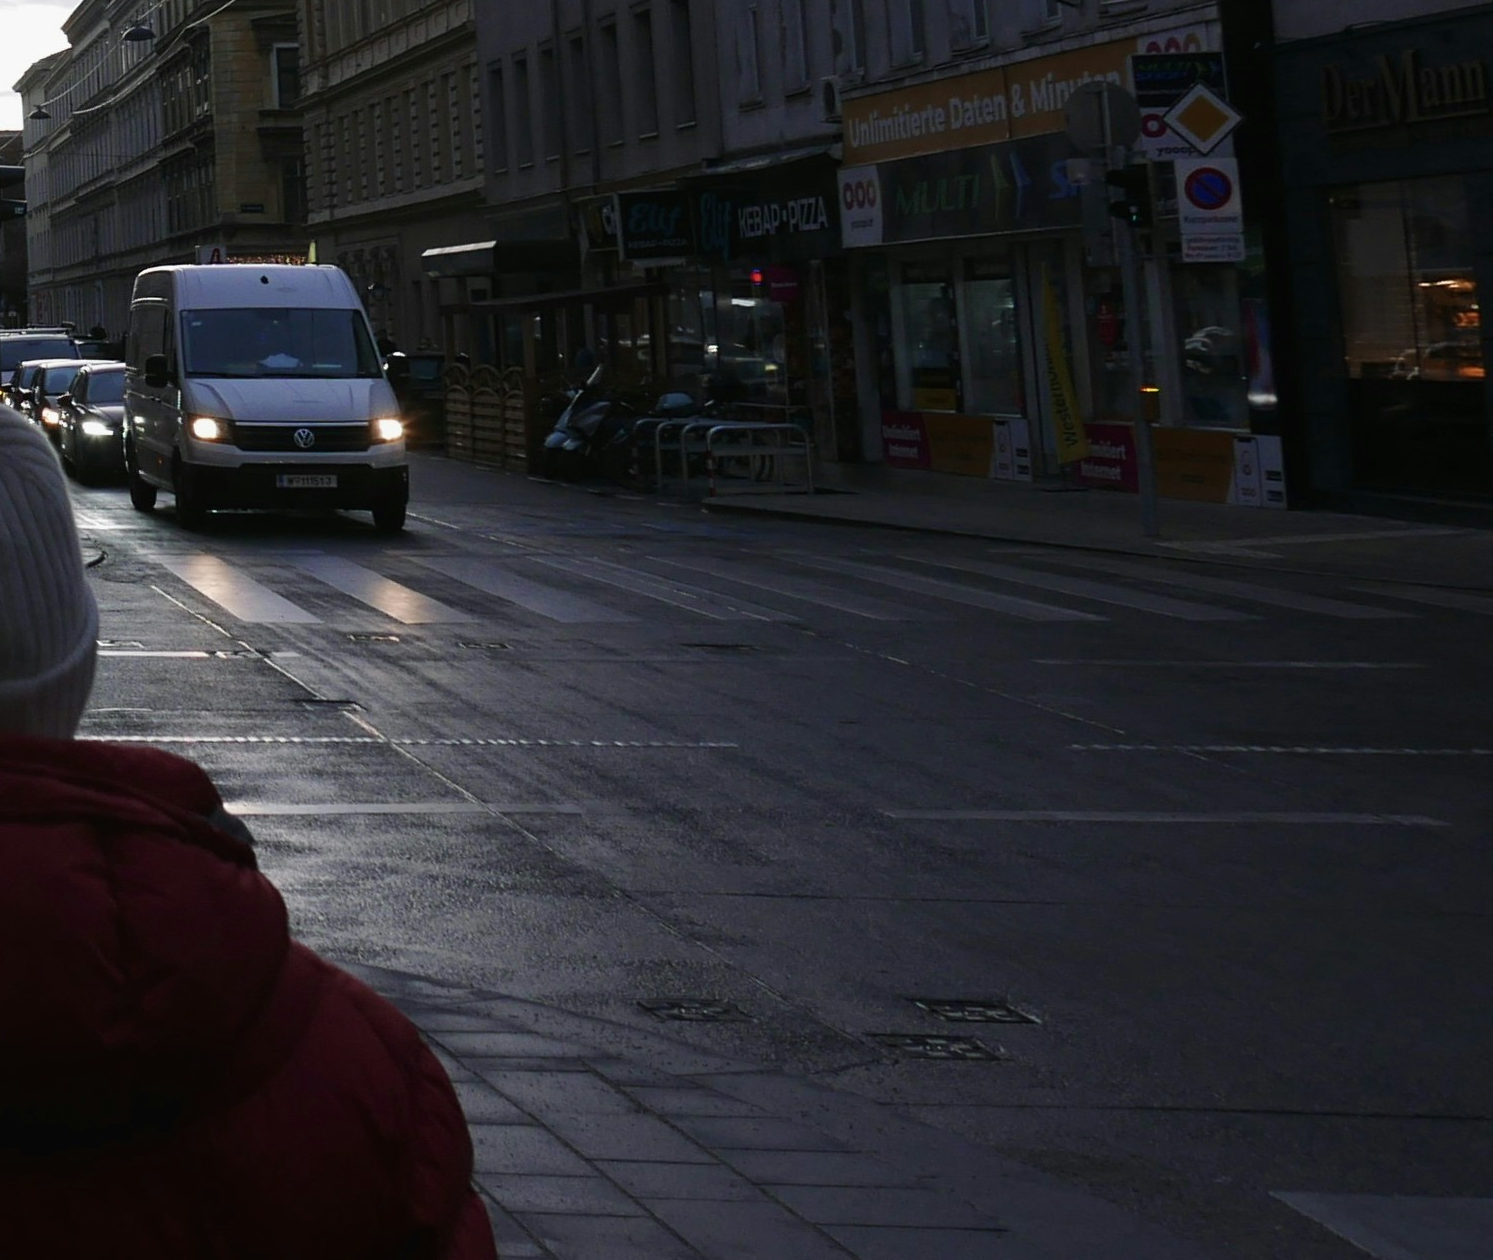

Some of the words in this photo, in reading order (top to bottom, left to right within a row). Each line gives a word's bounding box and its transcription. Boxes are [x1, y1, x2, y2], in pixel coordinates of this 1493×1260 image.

[849, 104, 946, 148] Unlimitierte
[950, 94, 1007, 130] Daten
[1011, 84, 1026, 118] &
[894, 172, 982, 217] MULTI
[629, 202, 685, 236] Elif
[739, 204, 780, 238] KEBAP
[788, 196, 829, 233] PIZZA
